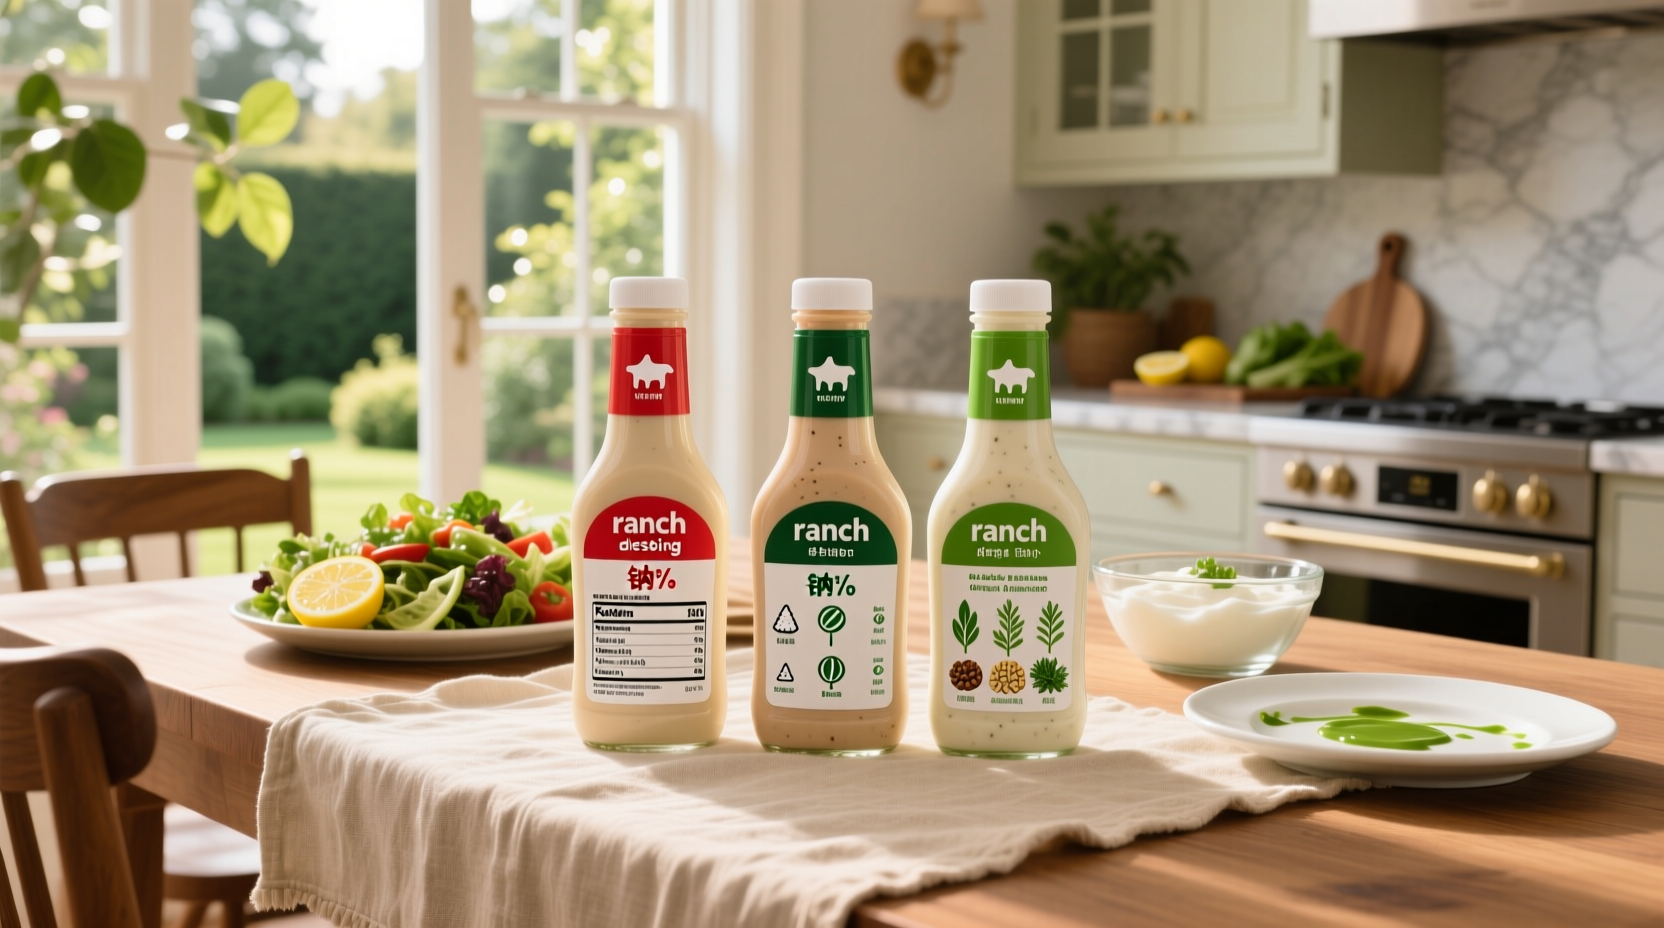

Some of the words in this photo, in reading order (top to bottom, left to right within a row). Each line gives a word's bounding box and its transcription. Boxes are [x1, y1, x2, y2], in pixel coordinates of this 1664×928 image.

[612, 510, 686, 534] ranch
[794, 516, 869, 542] ranch
[971, 517, 1047, 542] ranch
